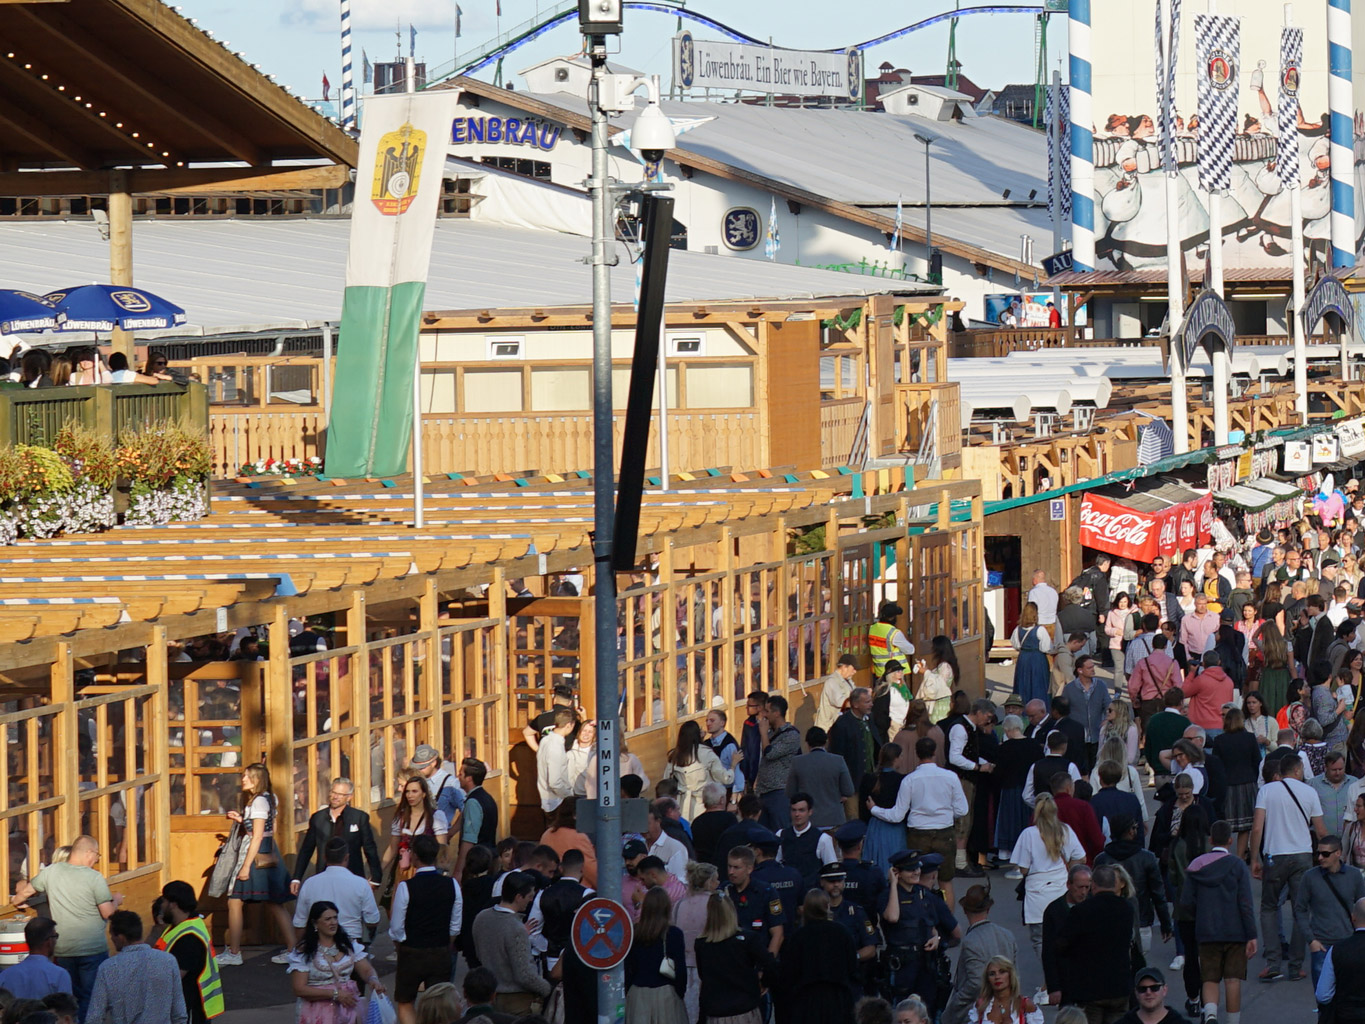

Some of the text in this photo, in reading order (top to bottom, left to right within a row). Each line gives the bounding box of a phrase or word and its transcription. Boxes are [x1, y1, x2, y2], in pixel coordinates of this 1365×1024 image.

[755, 56, 771, 84] Ein
[774, 58, 791, 87] Bier
[794, 61, 808, 86] wie
[451, 116, 562, 152] ENBRÄU
[10, 318, 56, 331] LÖWENBRÄU
[123, 318, 167, 329] LÖWENBRÄU
[771, 880, 794, 889] POLIZEI
[843, 881, 858, 889] IZEI
